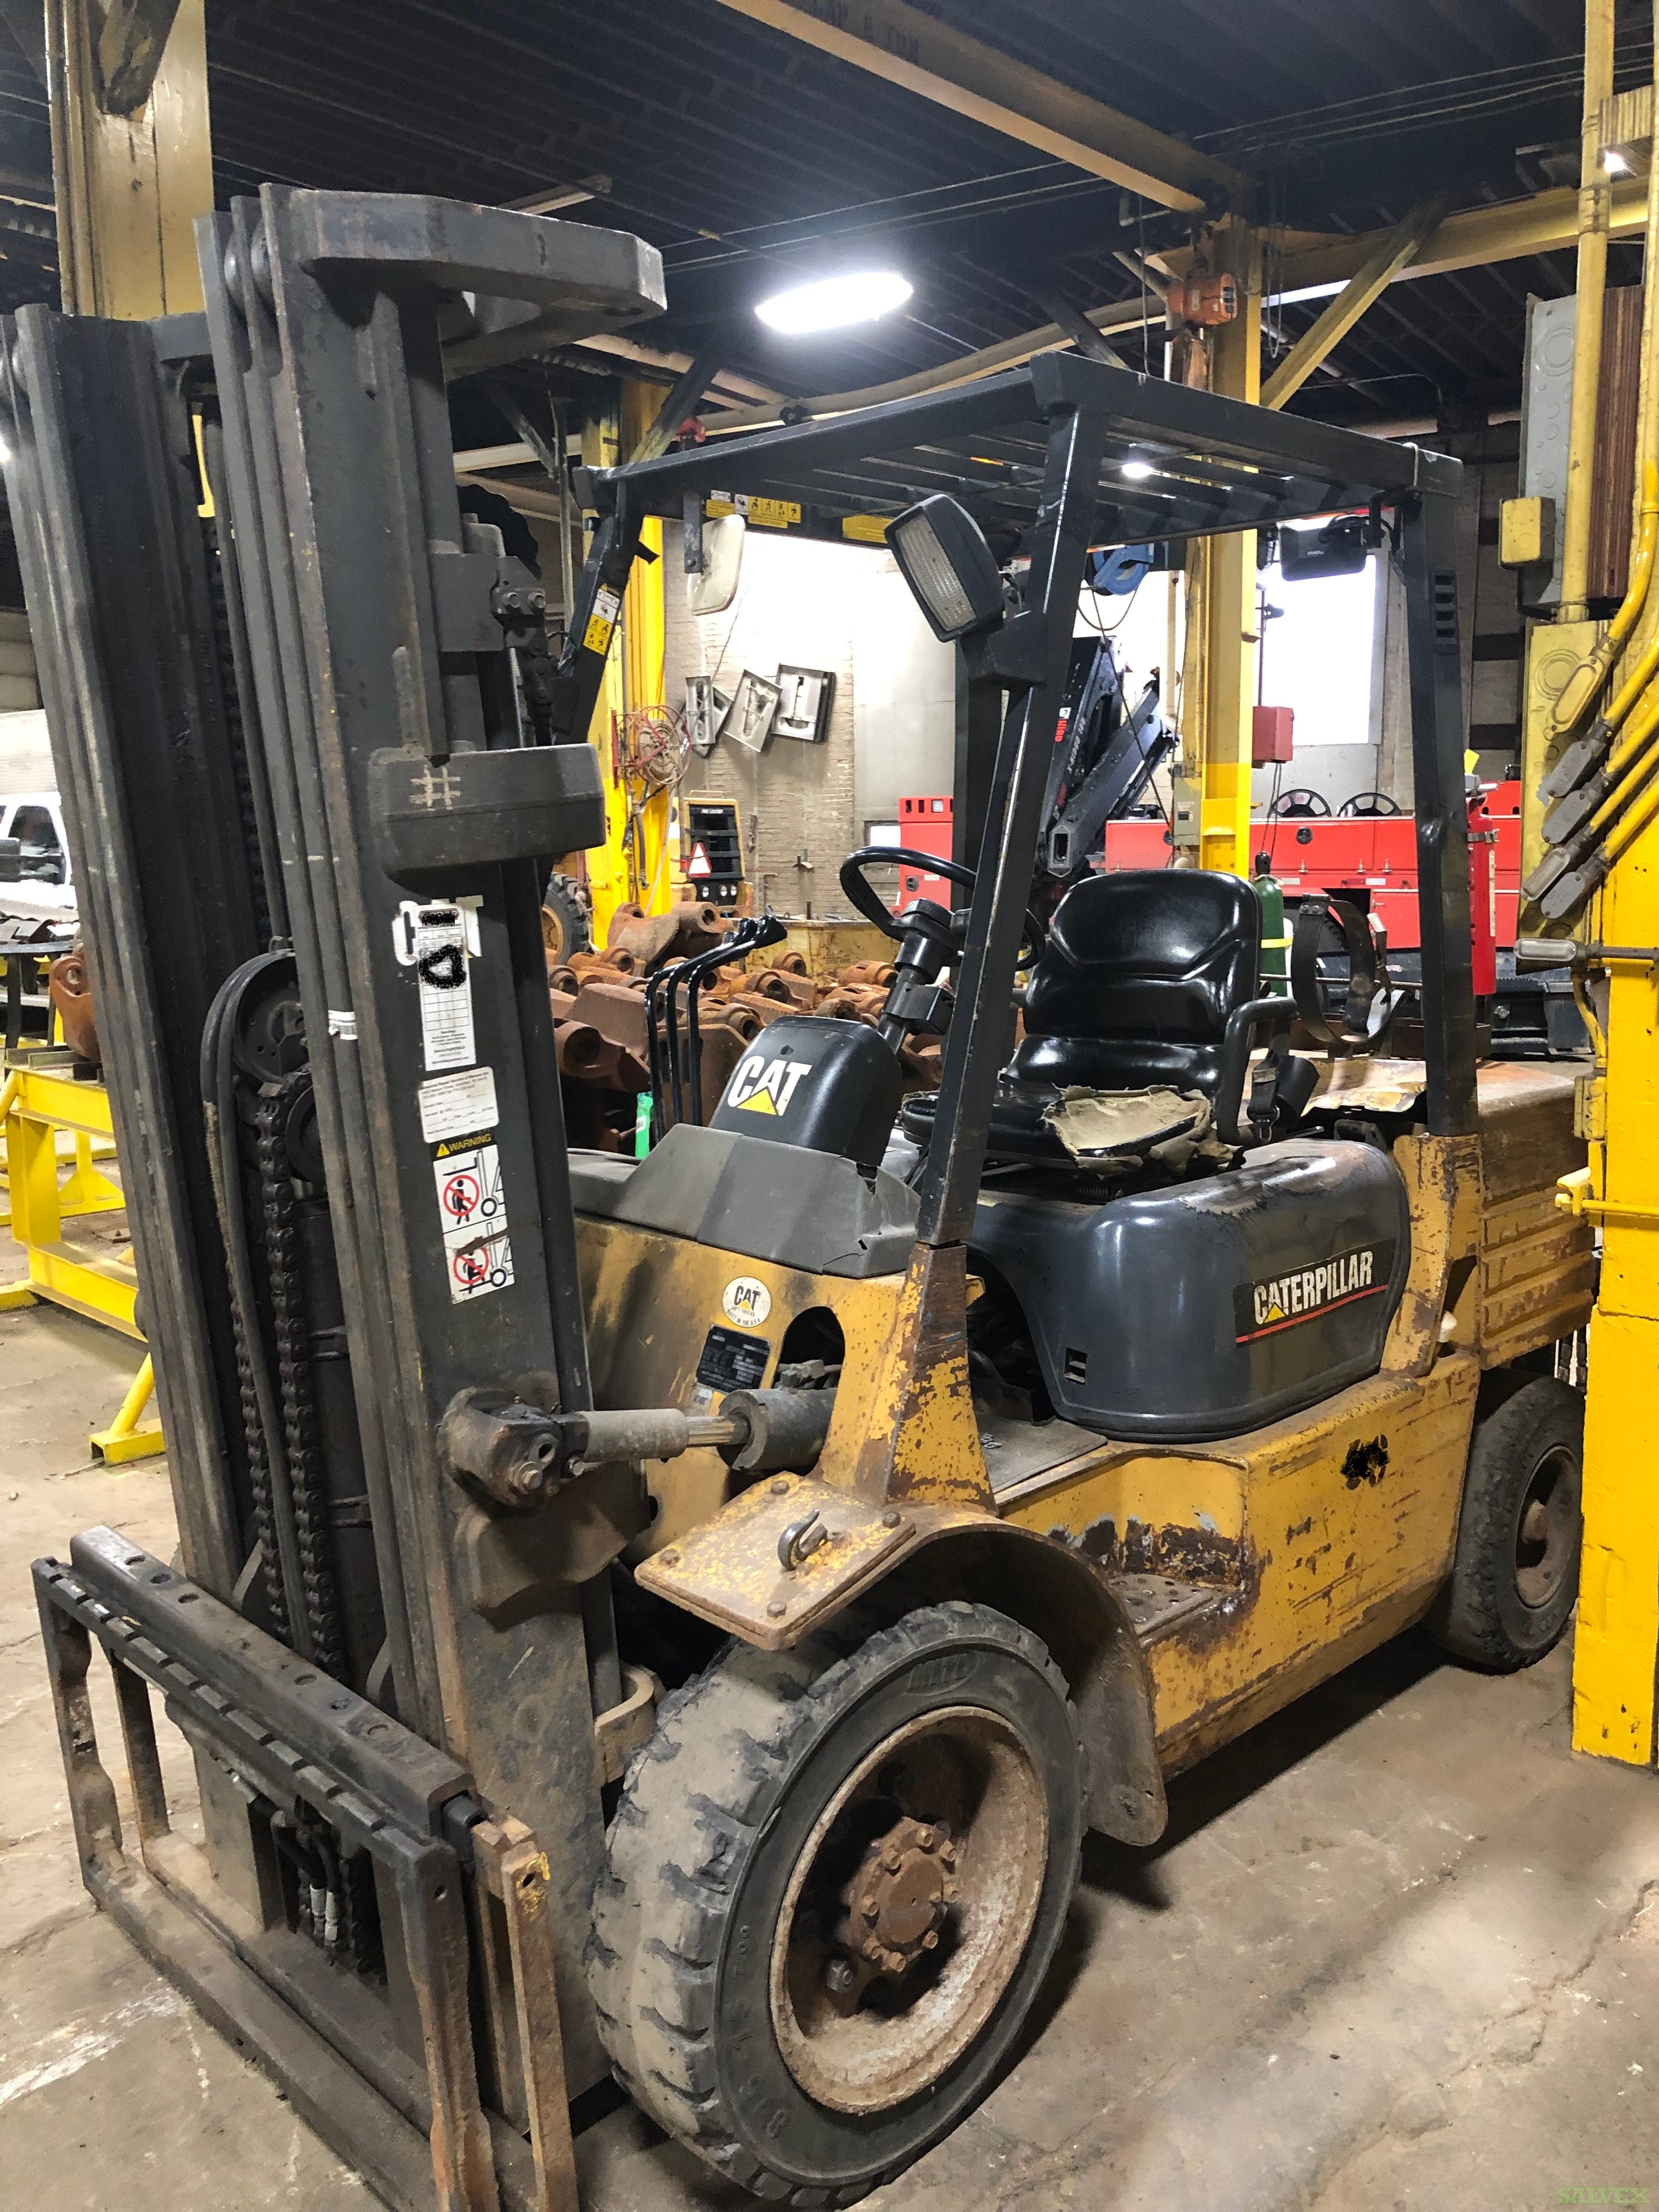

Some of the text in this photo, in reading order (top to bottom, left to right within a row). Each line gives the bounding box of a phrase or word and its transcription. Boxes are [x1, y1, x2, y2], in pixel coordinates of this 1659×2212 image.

[727, 1056, 812, 1117] CAT
[448, 1133, 492, 1152] WARNING
[733, 1285, 763, 1311] CAT
[1254, 1250, 1373, 1325] CATERPILLAR
